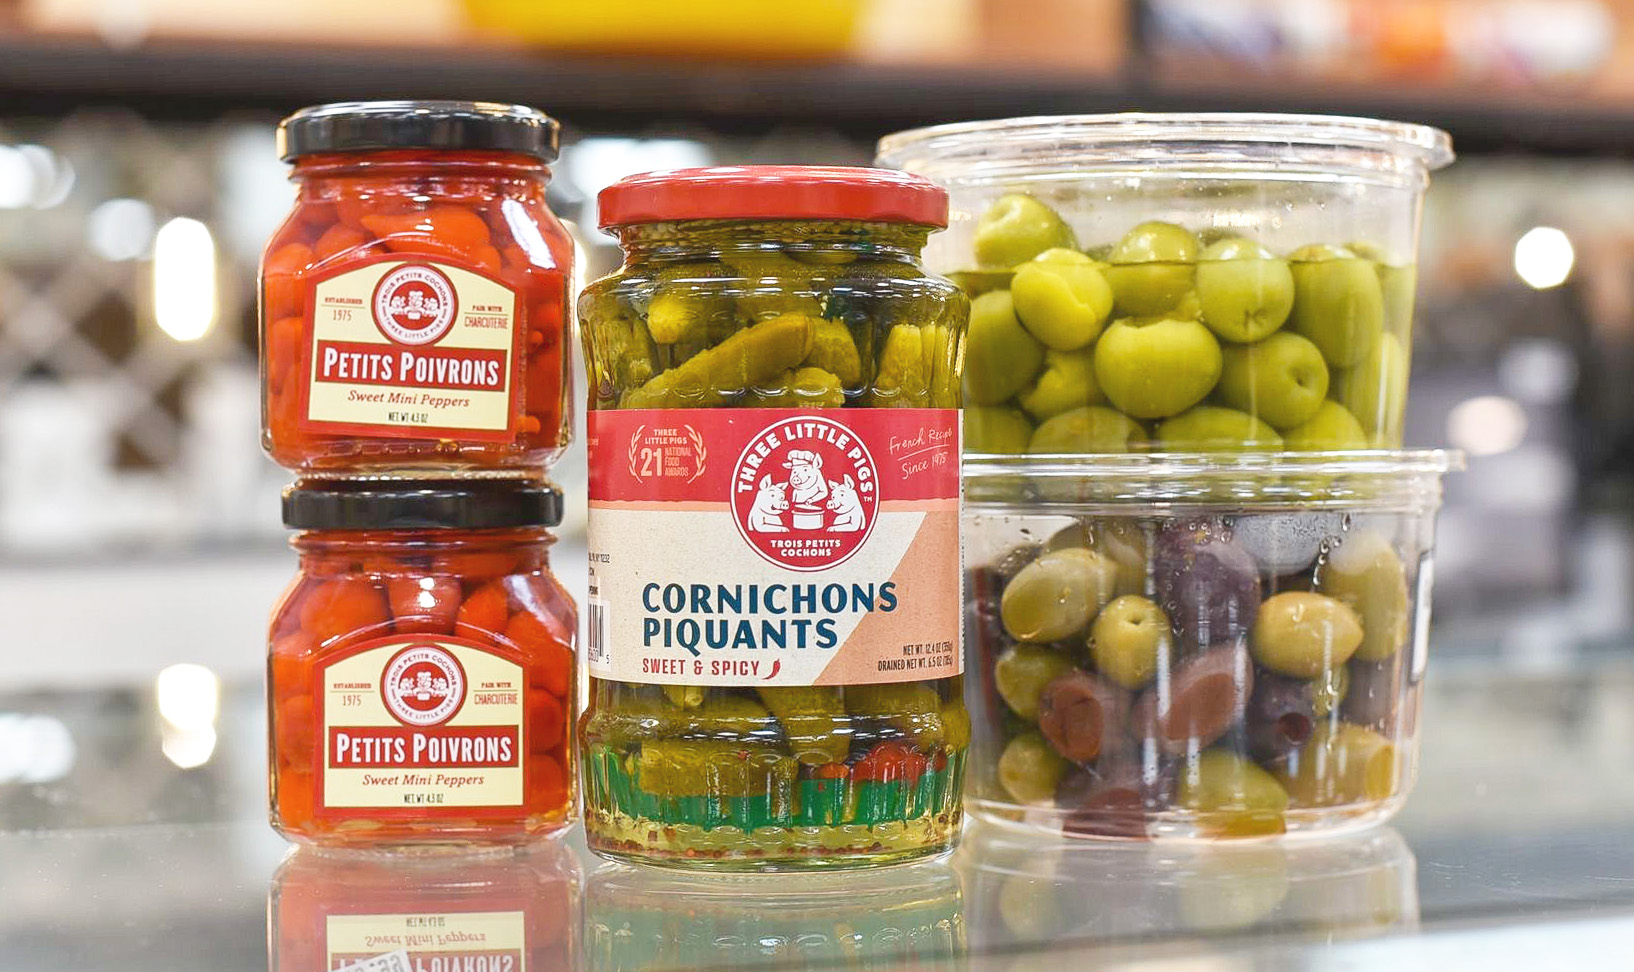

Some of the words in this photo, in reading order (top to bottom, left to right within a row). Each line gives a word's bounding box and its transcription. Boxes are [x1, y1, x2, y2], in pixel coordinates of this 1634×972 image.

[333, 309, 352, 321] 1975
[464, 316, 508, 329] CHARCUTERIE
[323, 347, 393, 380] PETITS
[400, 352, 499, 385] POIVRONS
[347, 390, 384, 403] Sweet
[387, 393, 417, 405] Mini
[420, 394, 470, 409] Peppers
[653, 428, 678, 436] THREE
[645, 437, 668, 445] LITTLE
[670, 437, 688, 445] PIGS
[889, 427, 925, 455] French
[665, 446, 692, 457] NATIONAL
[737, 432, 782, 494] THREE
[784, 422, 850, 451] LITTLE
[847, 446, 874, 493] PIGS
[640, 447, 663, 477] 21
[665, 456, 680, 466] FOOD
[902, 460, 929, 480] Since
[931, 451, 949, 469] 1975
[664, 467, 689, 477] AWARDS
[770, 539, 803, 548] TROIS
[805, 539, 841, 548] PETITS
[781, 548, 832, 557] COCHONS
[642, 582, 897, 614] CORNICHONS
[643, 617, 838, 657] PIQUANTS
[903, 644, 914, 656] NET
[642, 658, 686, 675] SWEET
[693, 660, 704, 675] &
[711, 660, 760, 676] SPICY
[878, 658, 905, 672] DRAINED
[907, 658, 917, 669] NET
[342, 695, 362, 706] 1975
[474, 693, 518, 706] CHARCUTERIE
[336, 733, 406, 763] PETITS
[412, 732, 512, 763] POIVRONS
[362, 774, 399, 786] Sweet
[402, 775, 431, 786] Mini
[435, 774, 484, 788] Peppers
